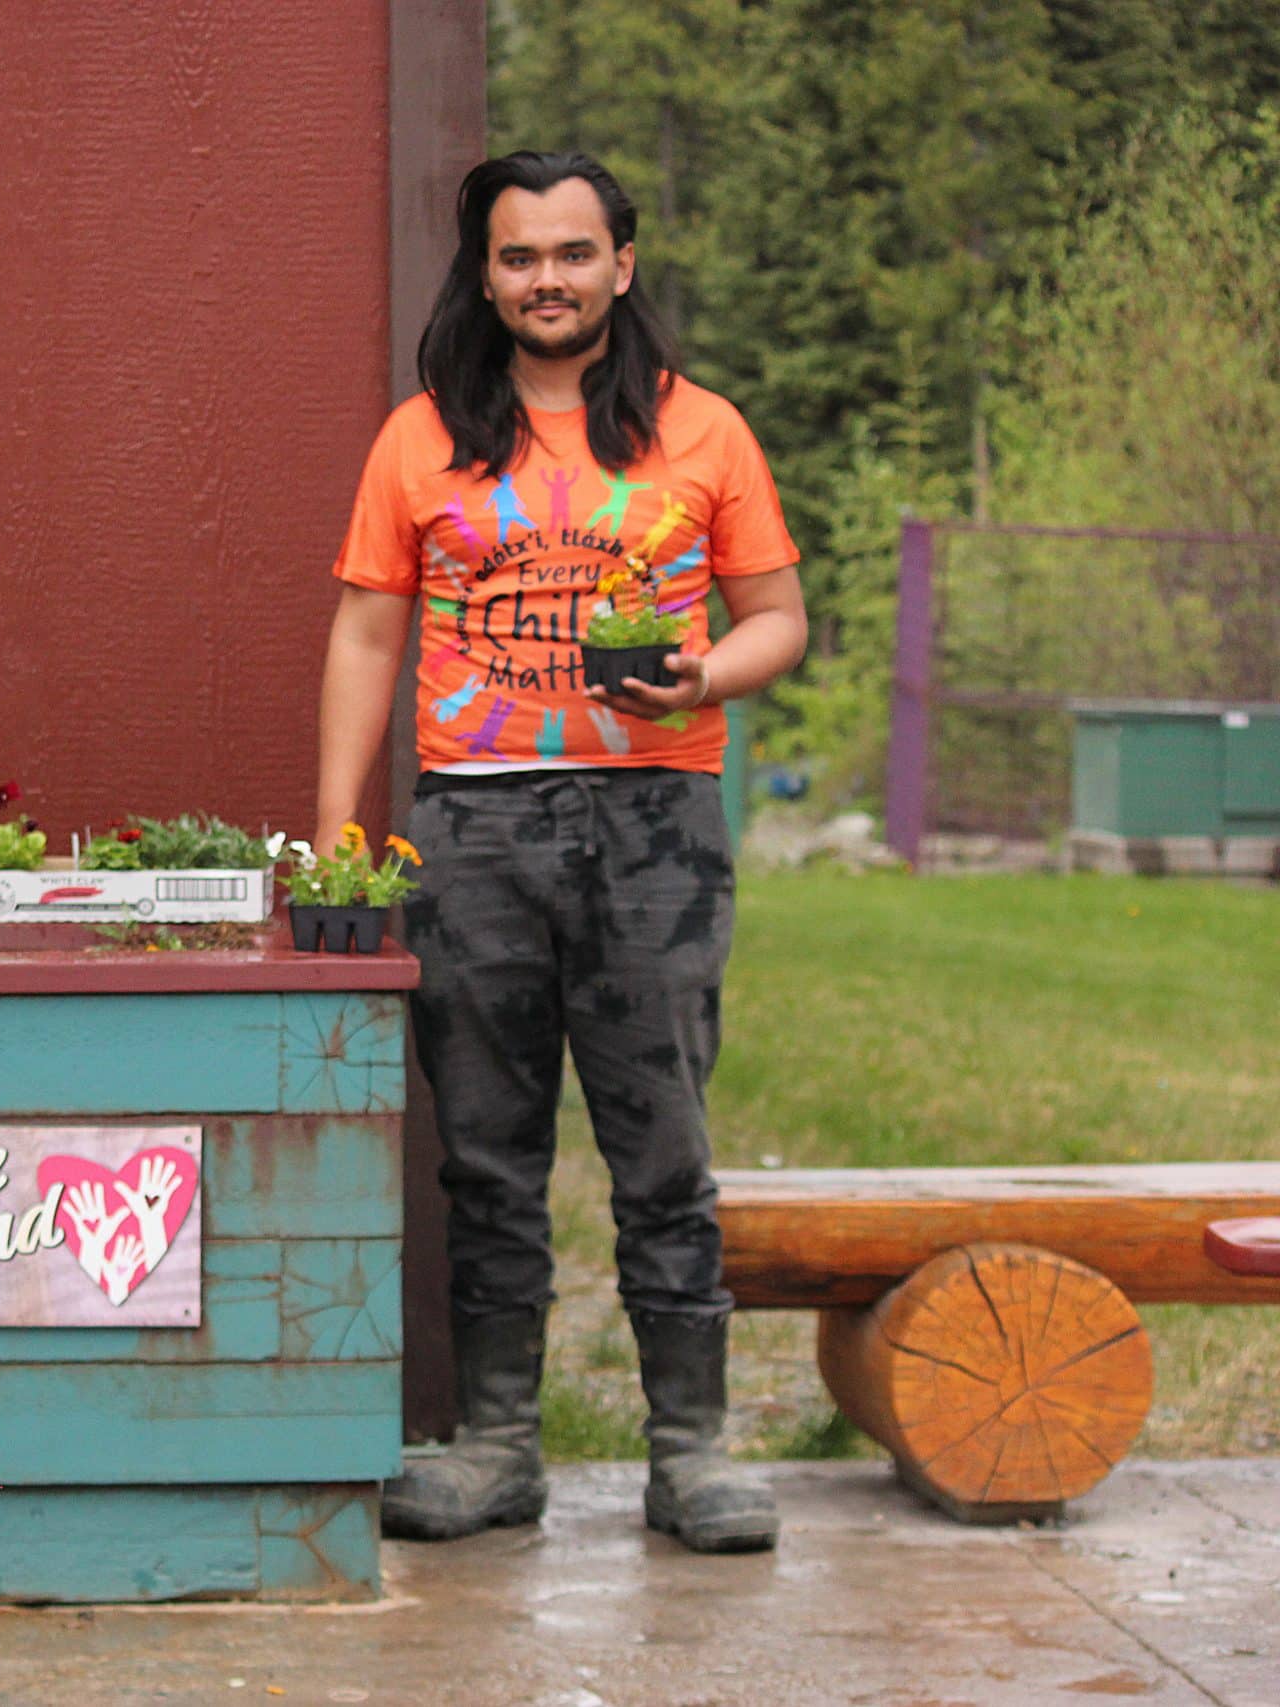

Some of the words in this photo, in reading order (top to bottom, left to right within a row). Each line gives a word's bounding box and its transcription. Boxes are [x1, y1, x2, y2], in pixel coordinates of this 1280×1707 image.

[518, 558, 601, 596] Every
[483, 589, 615, 651] Chil
[484, 650, 584, 691] Matt
